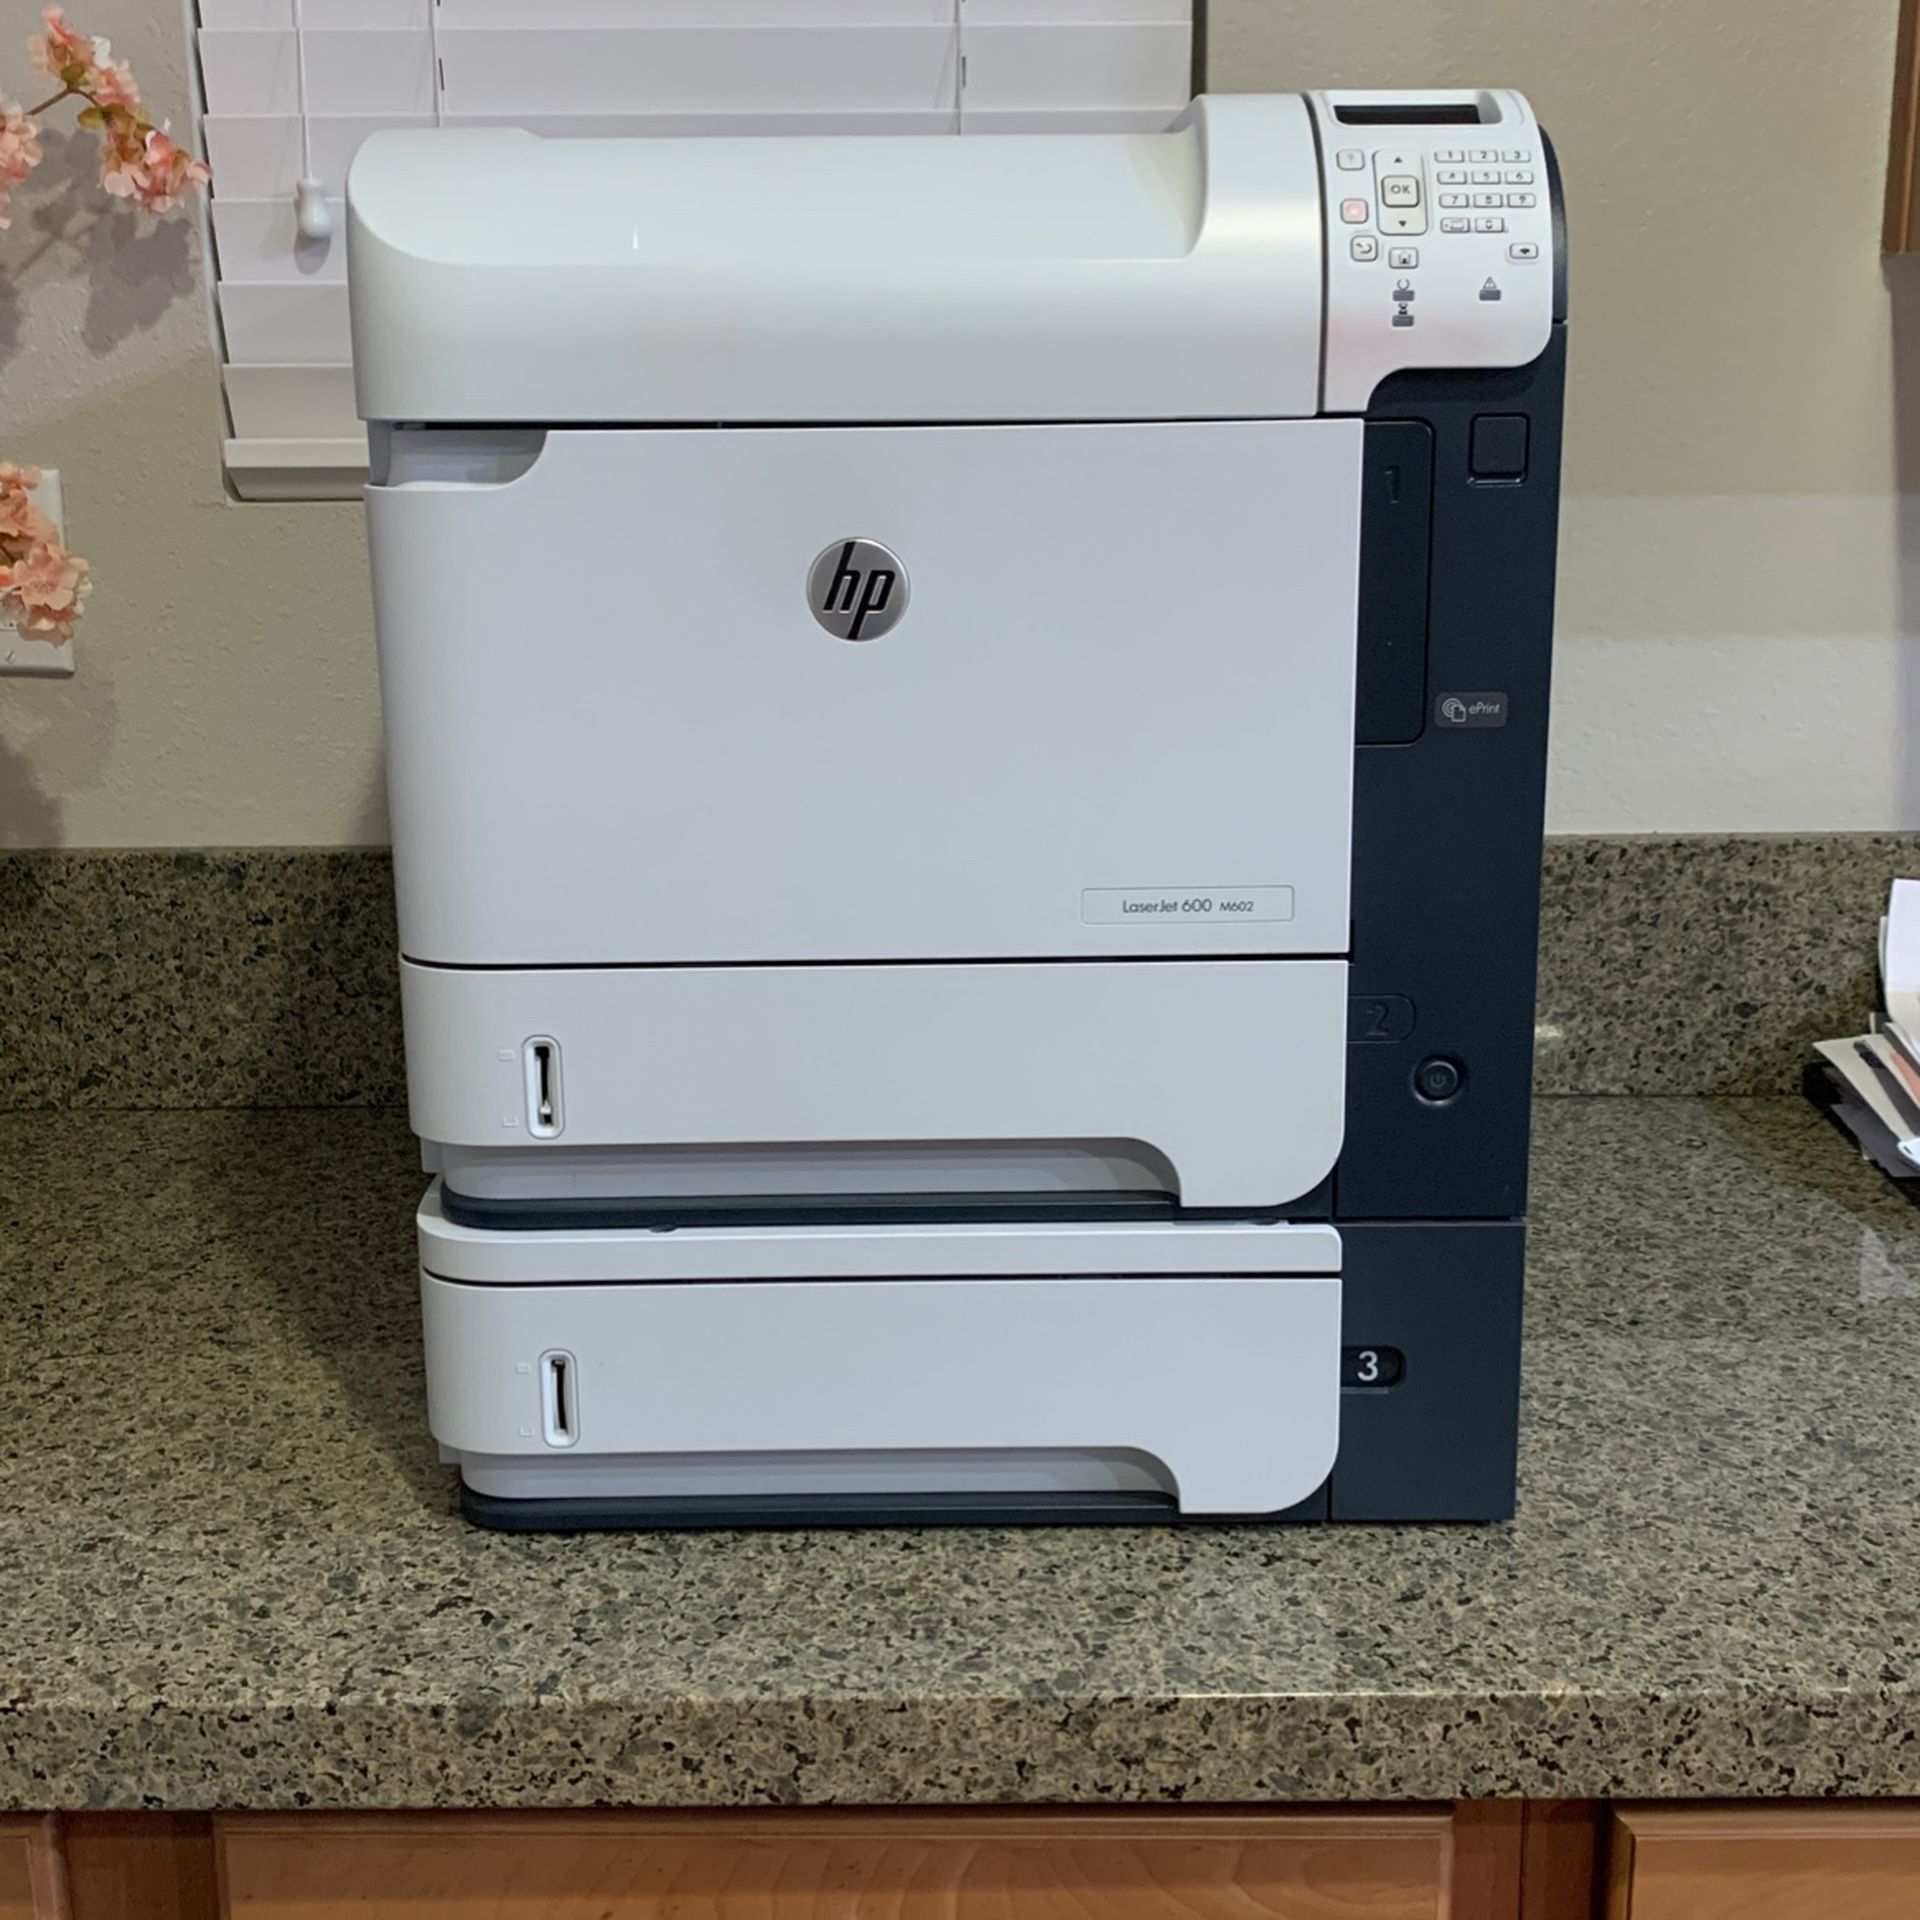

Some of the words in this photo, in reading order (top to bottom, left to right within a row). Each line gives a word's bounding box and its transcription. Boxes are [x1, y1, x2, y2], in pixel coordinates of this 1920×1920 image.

[1390, 184, 1411, 195] OK
[822, 541, 896, 641] hp
[1468, 701, 1501, 715] ePrint
[1122, 899, 1178, 914] LaserJet
[1181, 898, 1213, 913] 600
[1219, 900, 1254, 912] M602
[1366, 1001, 1390, 1036] 2
[1357, 1350, 1379, 1382] 3
